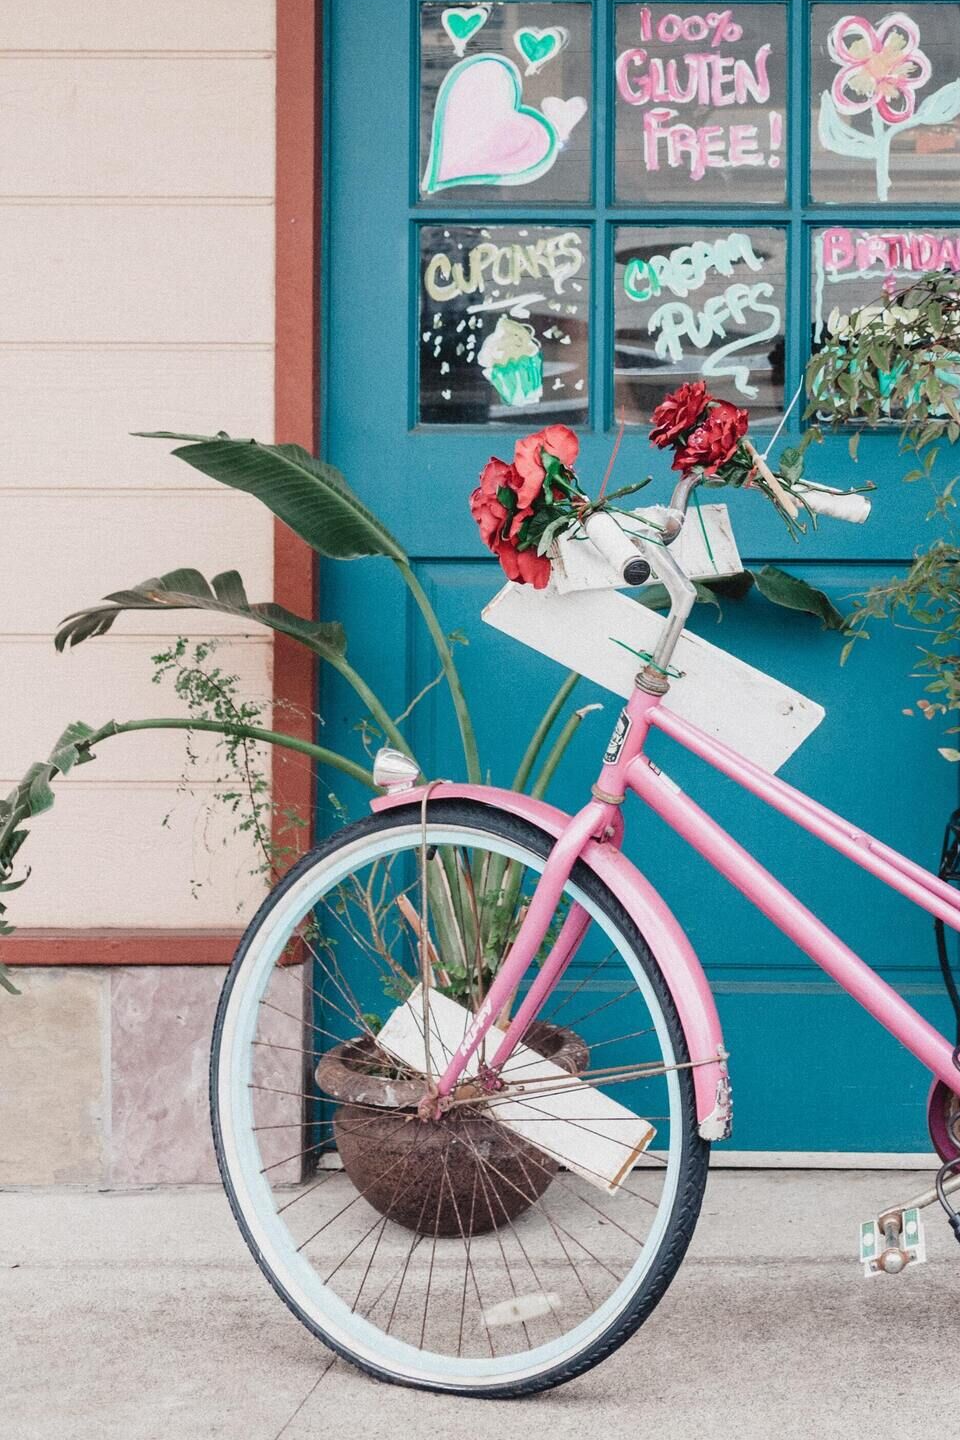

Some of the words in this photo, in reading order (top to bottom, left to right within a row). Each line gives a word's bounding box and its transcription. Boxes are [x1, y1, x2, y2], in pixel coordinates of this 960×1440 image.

[640, 8, 743, 47] 100%
[616, 44, 772, 106] GLUTEN
[643, 108, 783, 181] FREE!
[624, 233, 764, 301] CREAM
[648, 283, 782, 398] PUFFS
